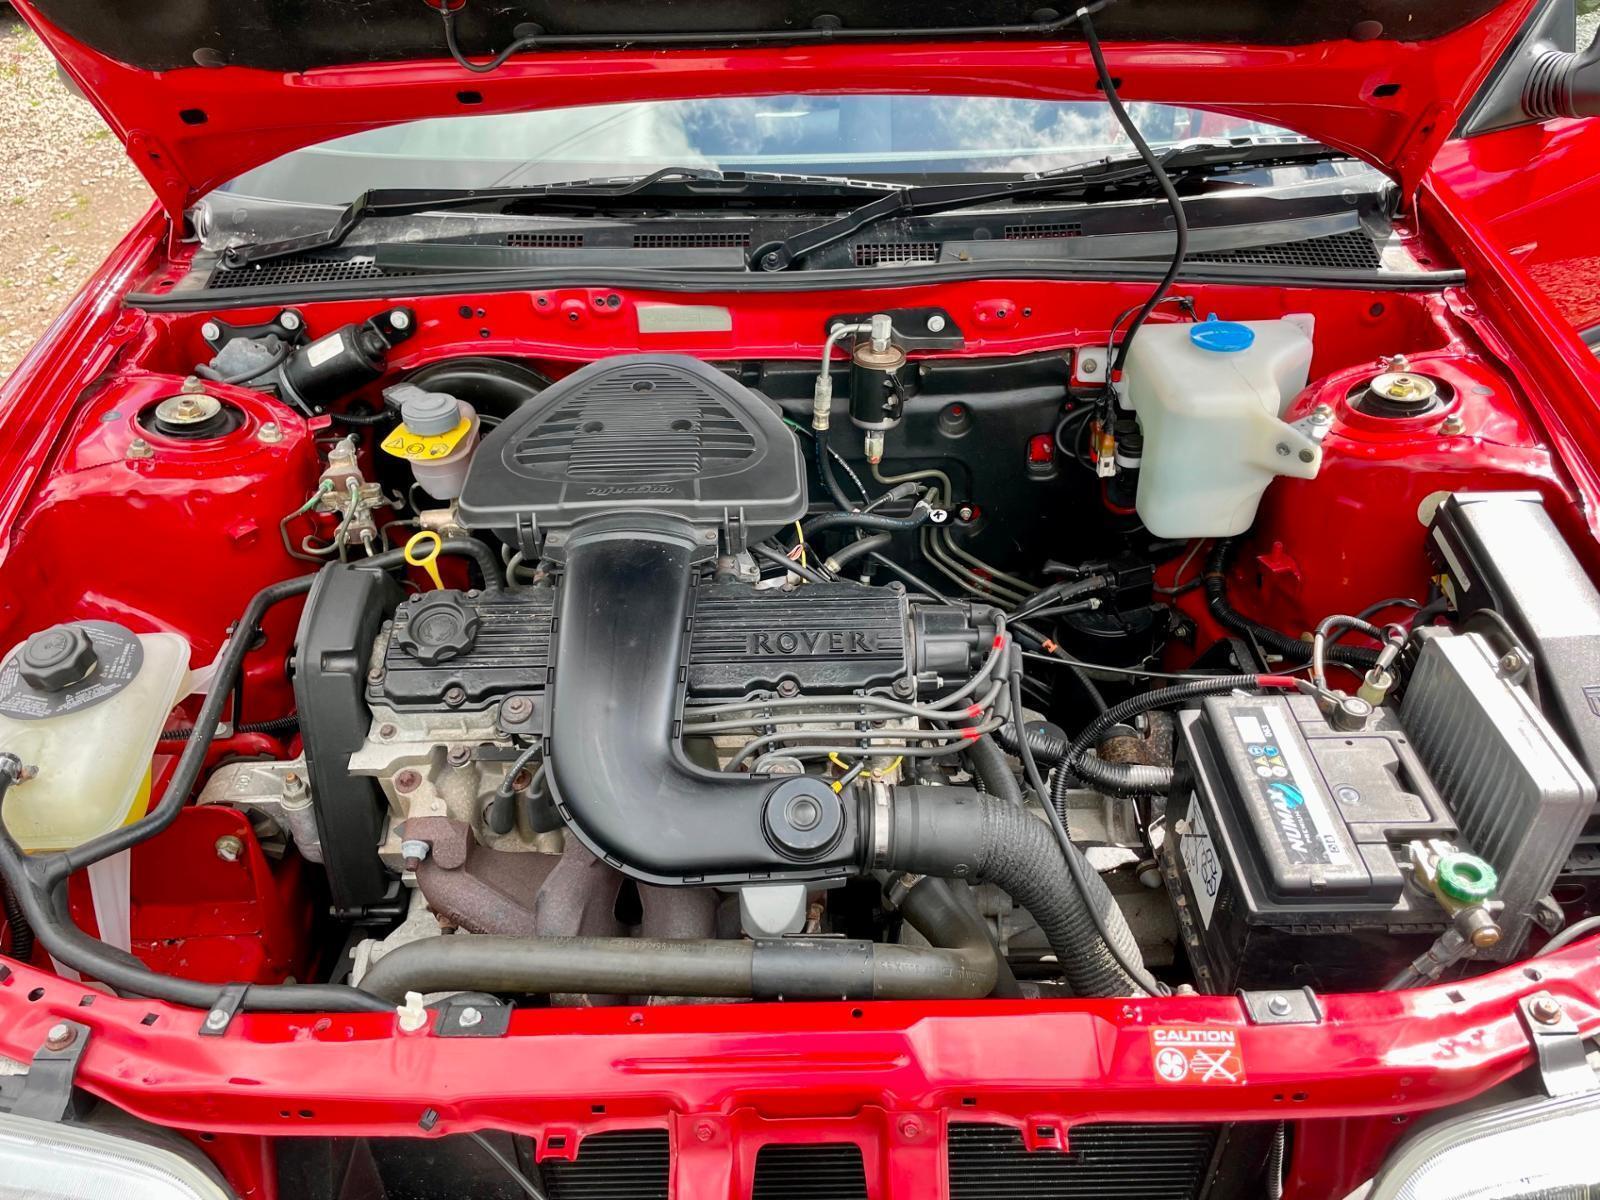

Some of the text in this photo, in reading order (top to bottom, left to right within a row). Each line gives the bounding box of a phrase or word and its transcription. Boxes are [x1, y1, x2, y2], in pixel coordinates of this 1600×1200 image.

[753, 631, 873, 654] ROVER
[1267, 788, 1309, 853] NUMAX
[1295, 810, 1313, 844] PREMIUM
[1153, 1029, 1235, 1041] CAUTION
